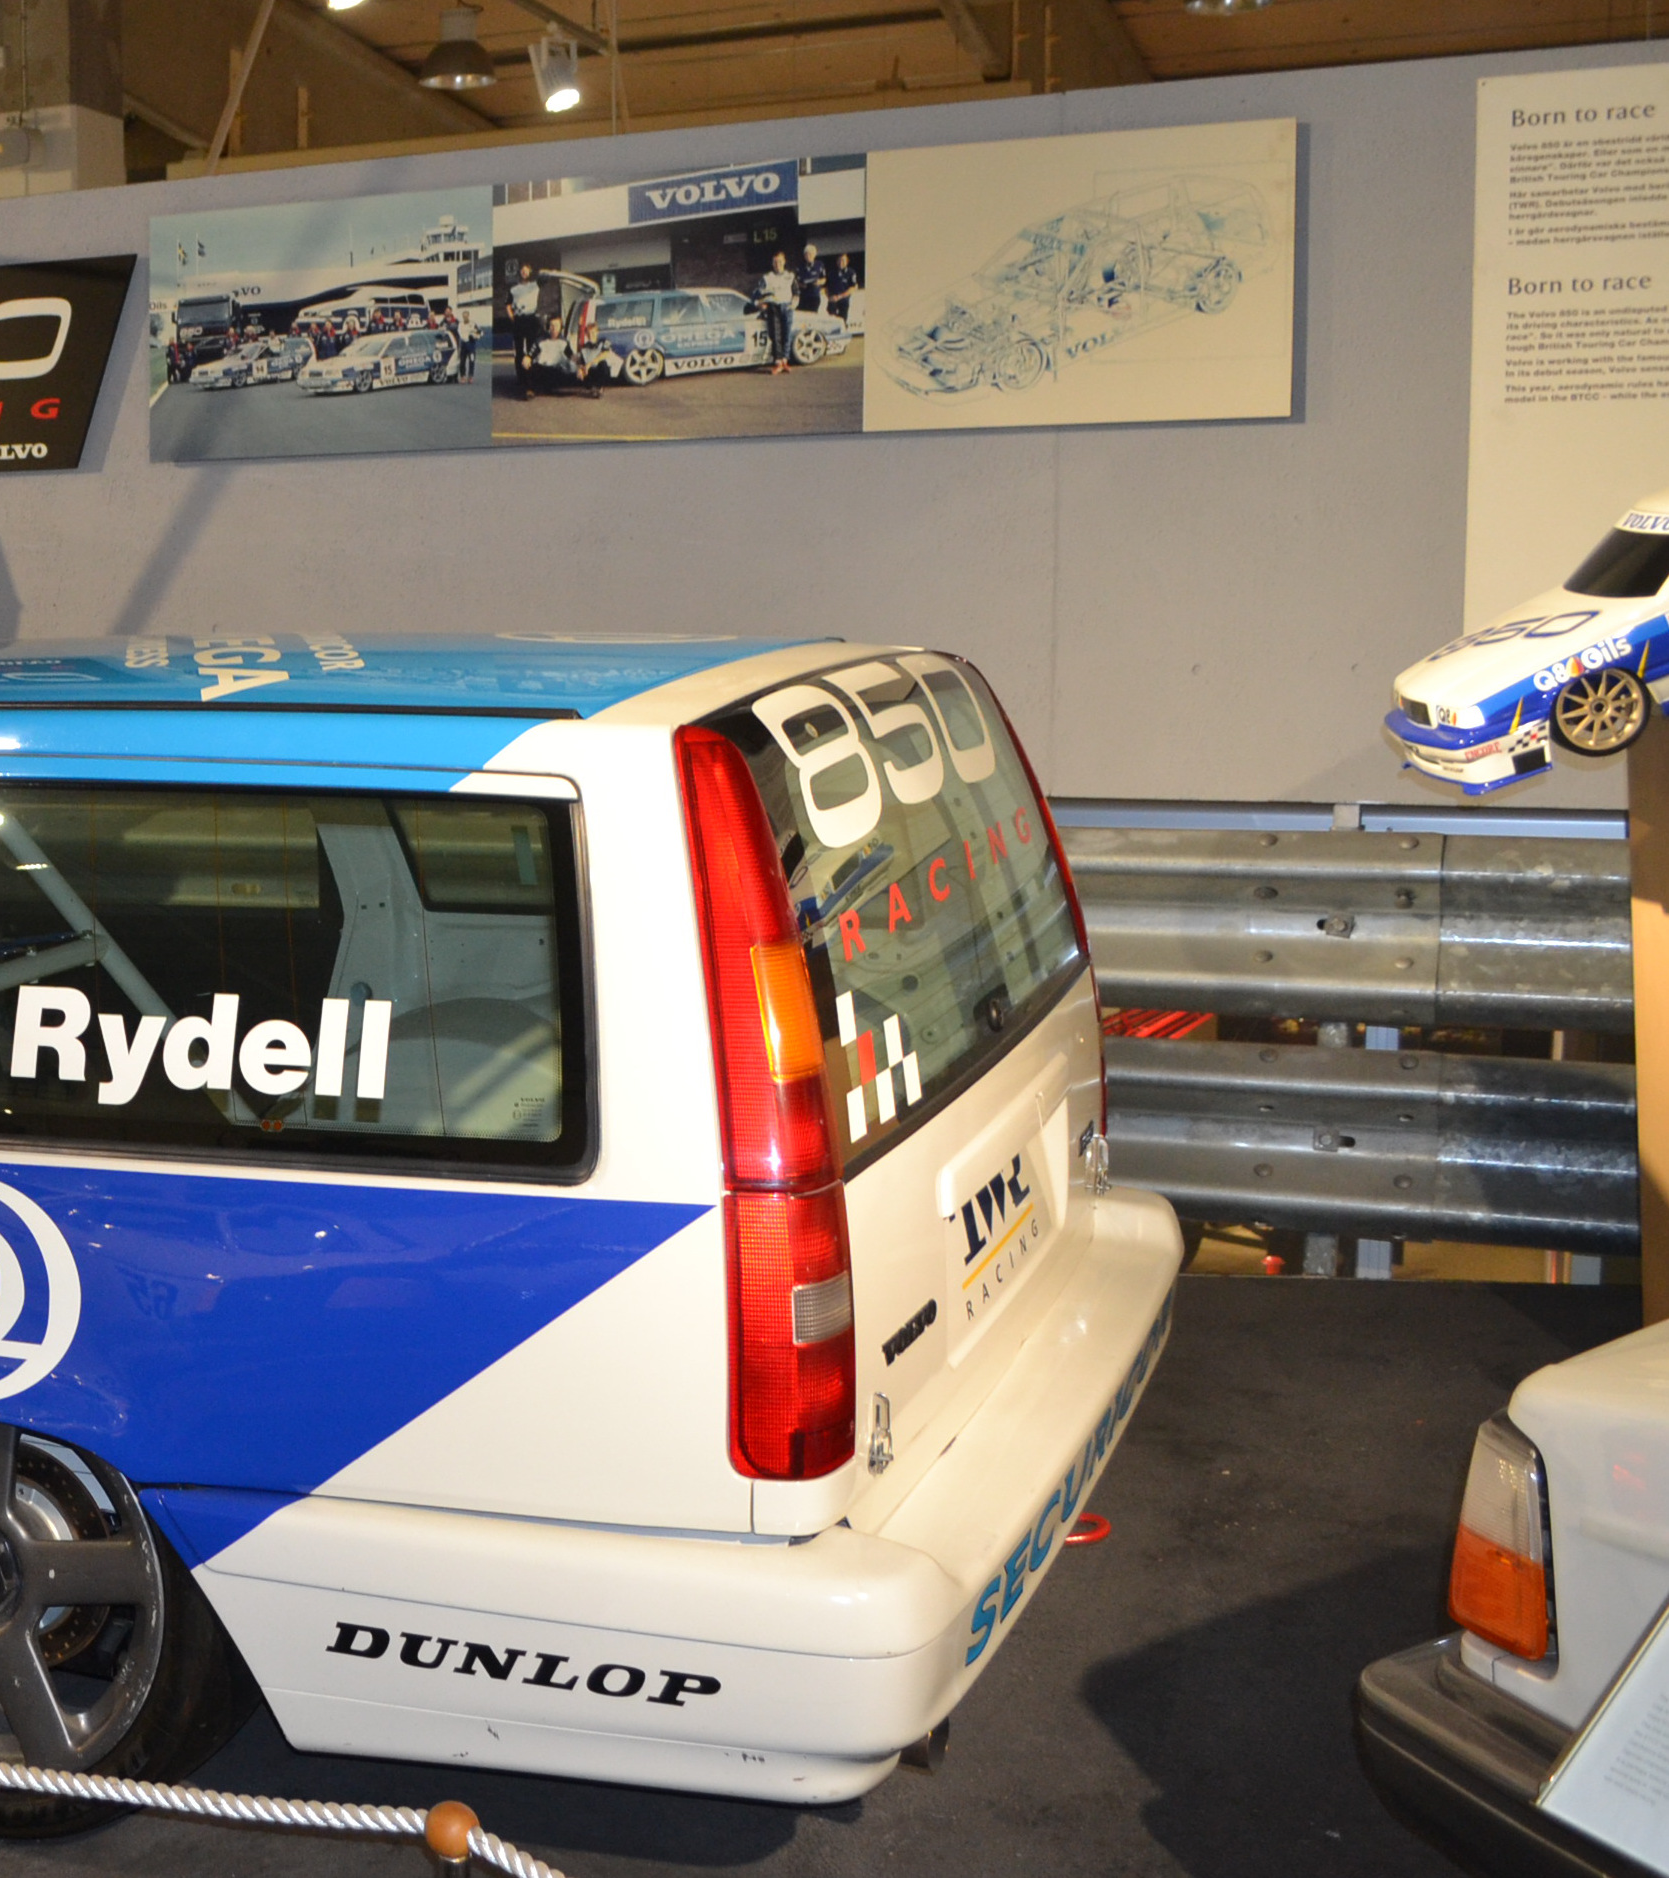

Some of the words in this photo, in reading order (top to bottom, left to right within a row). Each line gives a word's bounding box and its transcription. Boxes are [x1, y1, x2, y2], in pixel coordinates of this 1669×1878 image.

[1511, 109, 1566, 127] Born
[1575, 108, 1598, 123] to
[1606, 105, 1656, 120] race
[1510, 142, 1537, 151] Volvo
[1541, 141, 1559, 149] 850
[1593, 148, 1617, 156] Eller
[1510, 174, 1543, 183] British
[1548, 172, 1586, 182] Touring
[1590, 170, 1606, 178] Car
[646, 172, 780, 209] VOLVO
[1592, 185, 1619, 193] Volvo
[1508, 277, 1563, 296] Born
[1571, 277, 1594, 292] to
[1602, 274, 1652, 291] race
[1528, 310, 1555, 318] Volvo
[1559, 309, 1577, 317] 850
[1608, 305, 1667, 316] undisputed
[1522, 321, 1557, 330] driving
[1589, 329, 1610, 338] only
[1613, 328, 1650, 336] natural
[661, 328, 735, 343] OMEGA
[751, 331, 768, 347] 15
[1506, 343, 1534, 353] tough
[1538, 342, 1572, 350] British
[1576, 340, 1614, 350] Touring
[1618, 339, 1635, 347] Car
[673, 355, 735, 370] VOLVO
[1505, 358, 1532, 366] Volvo
[1547, 356, 1588, 366] working
[1591, 355, 1613, 363] with
[1533, 368, 1562, 376] debut
[1608, 365, 1636, 373] Volvo
[1558, 381, 1623, 392] aerodynamic
[1627, 380, 1653, 388] rules
[1427, 610, 1602, 661] 850
[1533, 663, 1569, 692] Q8
[1580, 636, 1632, 669] Oils
[751, 653, 996, 849] 850
[838, 806, 1031, 964] RACING
[10, 985, 392, 1105] Rydell
[966, 1219, 1039, 1321] RACING
[881, 1298, 938, 1368] VOLVO
[325, 1621, 722, 1707] DUNLOP
